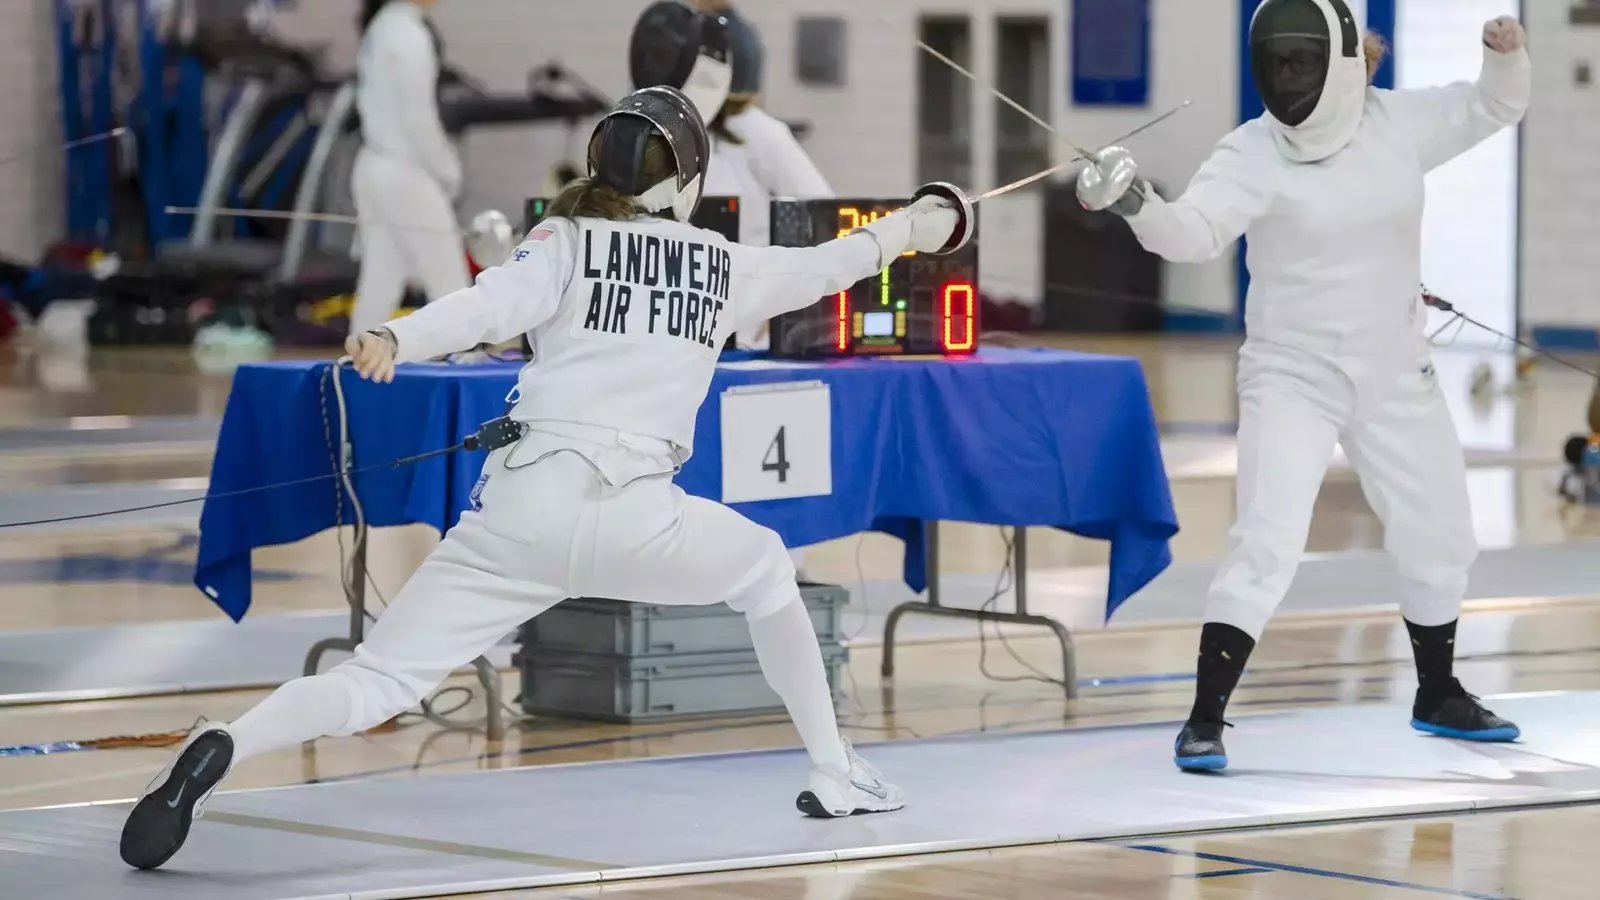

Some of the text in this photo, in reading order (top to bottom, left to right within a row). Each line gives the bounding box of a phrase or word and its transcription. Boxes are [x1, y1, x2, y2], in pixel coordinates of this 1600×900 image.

[584, 229, 731, 300] LANDWEHR
[583, 282, 724, 349] AIR FORCE
[838, 289, 847, 350] 1
[943, 284, 974, 350] 0
[761, 425, 790, 483] 4
